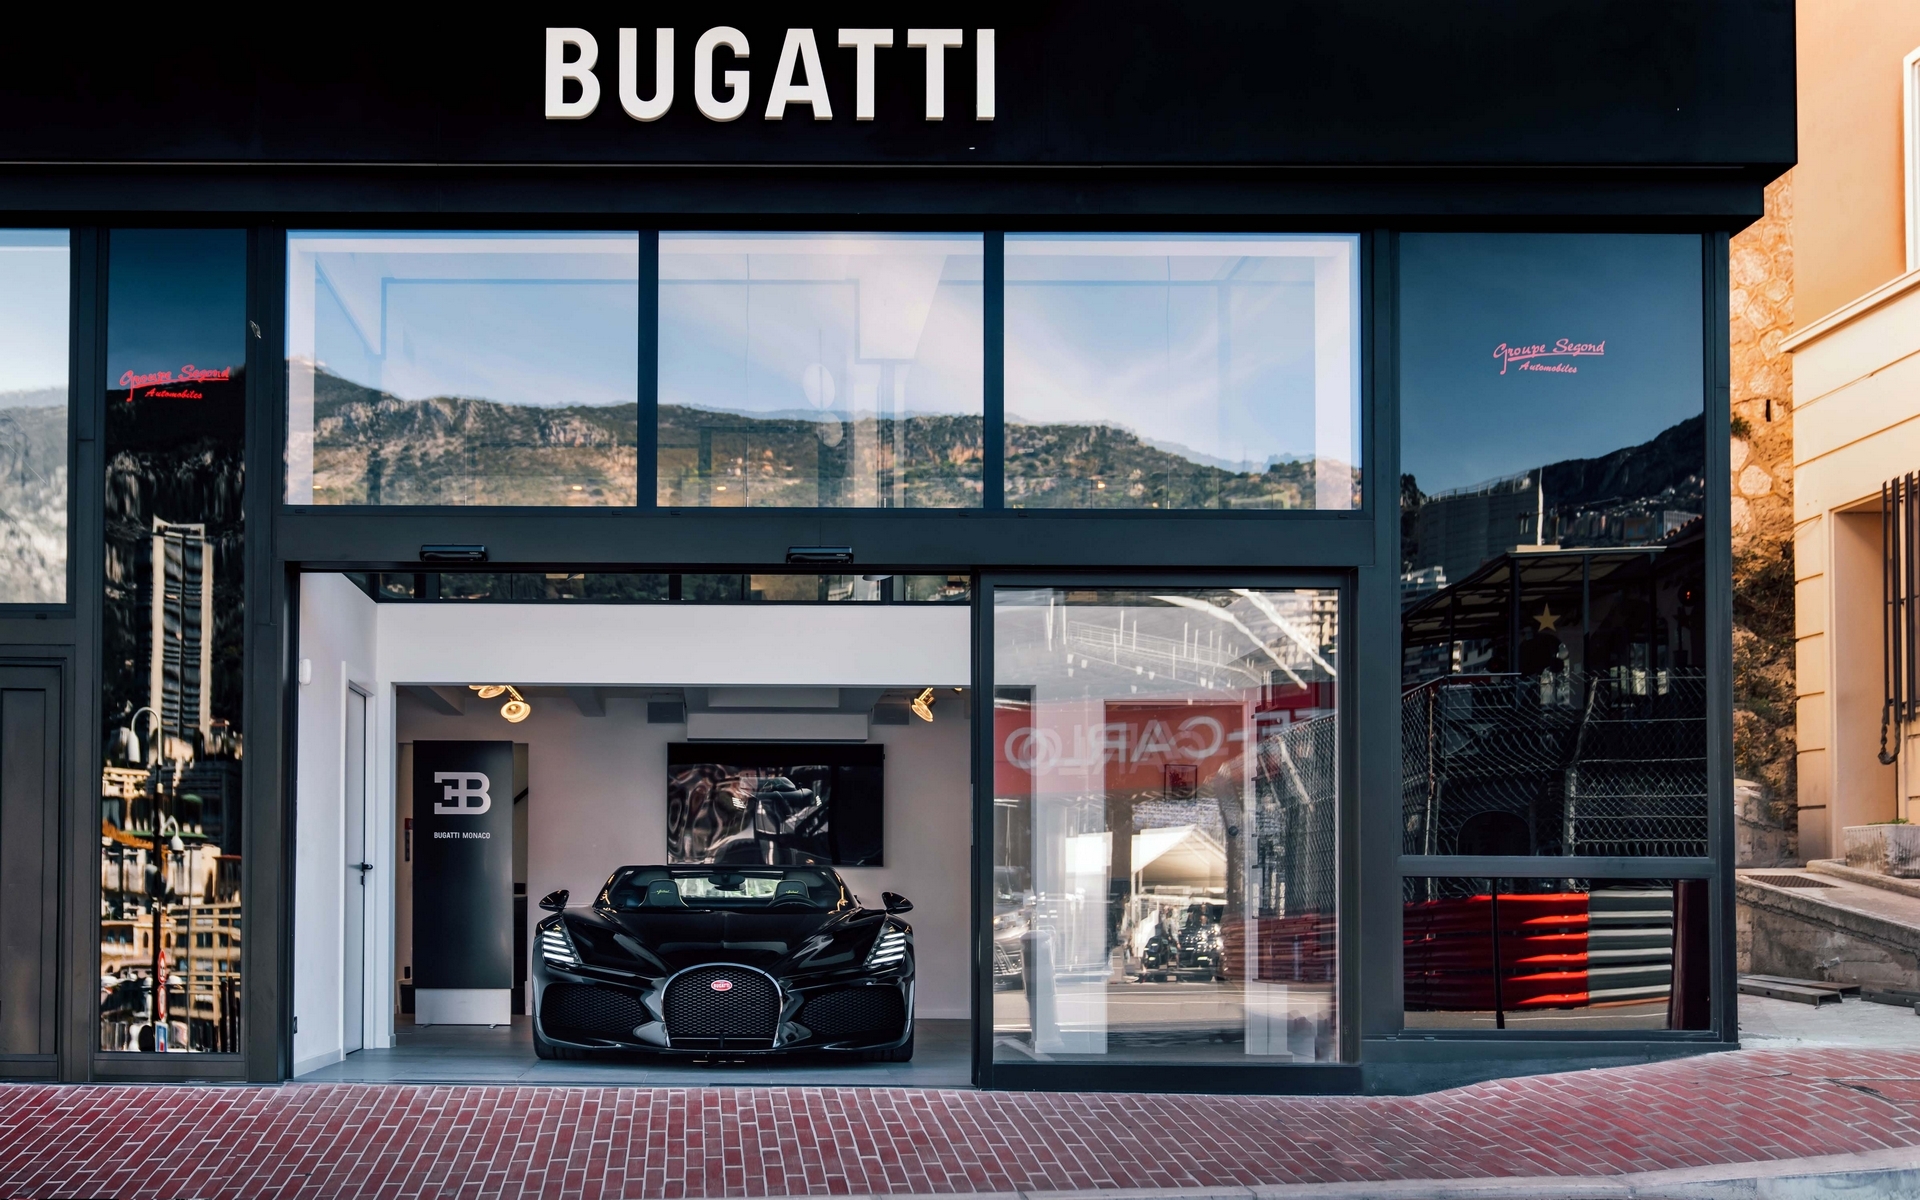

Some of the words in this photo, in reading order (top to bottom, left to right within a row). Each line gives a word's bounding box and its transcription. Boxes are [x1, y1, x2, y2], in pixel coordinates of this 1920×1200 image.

[545, 26, 996, 122] BUGATTI
[1493, 343, 1546, 375] Groupe
[1553, 338, 1606, 357] Segond
[1519, 361, 1578, 374] Automobiles
[119, 370, 173, 402] Groupe
[178, 364, 231, 383] Segond
[144, 388, 203, 400] Automobiles
[433, 831, 460, 839] BUGATTI
[462, 831, 491, 839] MONACO
